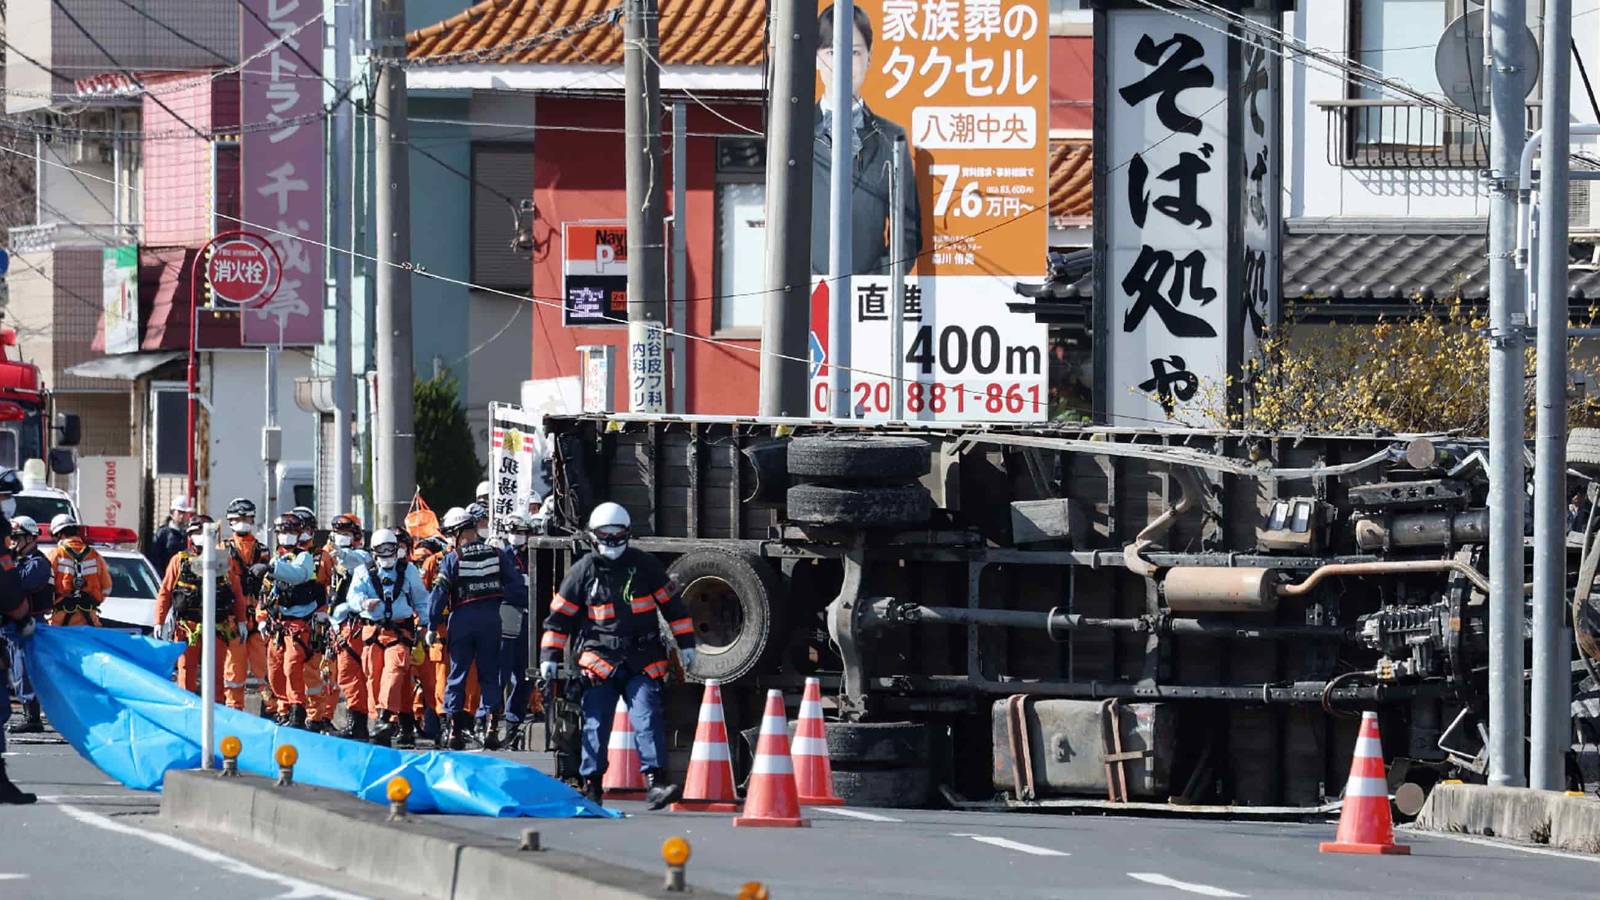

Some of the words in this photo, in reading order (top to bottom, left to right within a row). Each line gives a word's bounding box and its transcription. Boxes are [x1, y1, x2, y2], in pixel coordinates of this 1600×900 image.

[882, 0, 1038, 42] 家族葬の
[882, 47, 1038, 98] タクセル
[920, 113, 1028, 143] 八潮中央
[1118, 33, 1218, 416] そば処や
[214, 260, 264, 284] 消火栓
[570, 287, 604, 318] 空
[905, 324, 1042, 375] 400m
